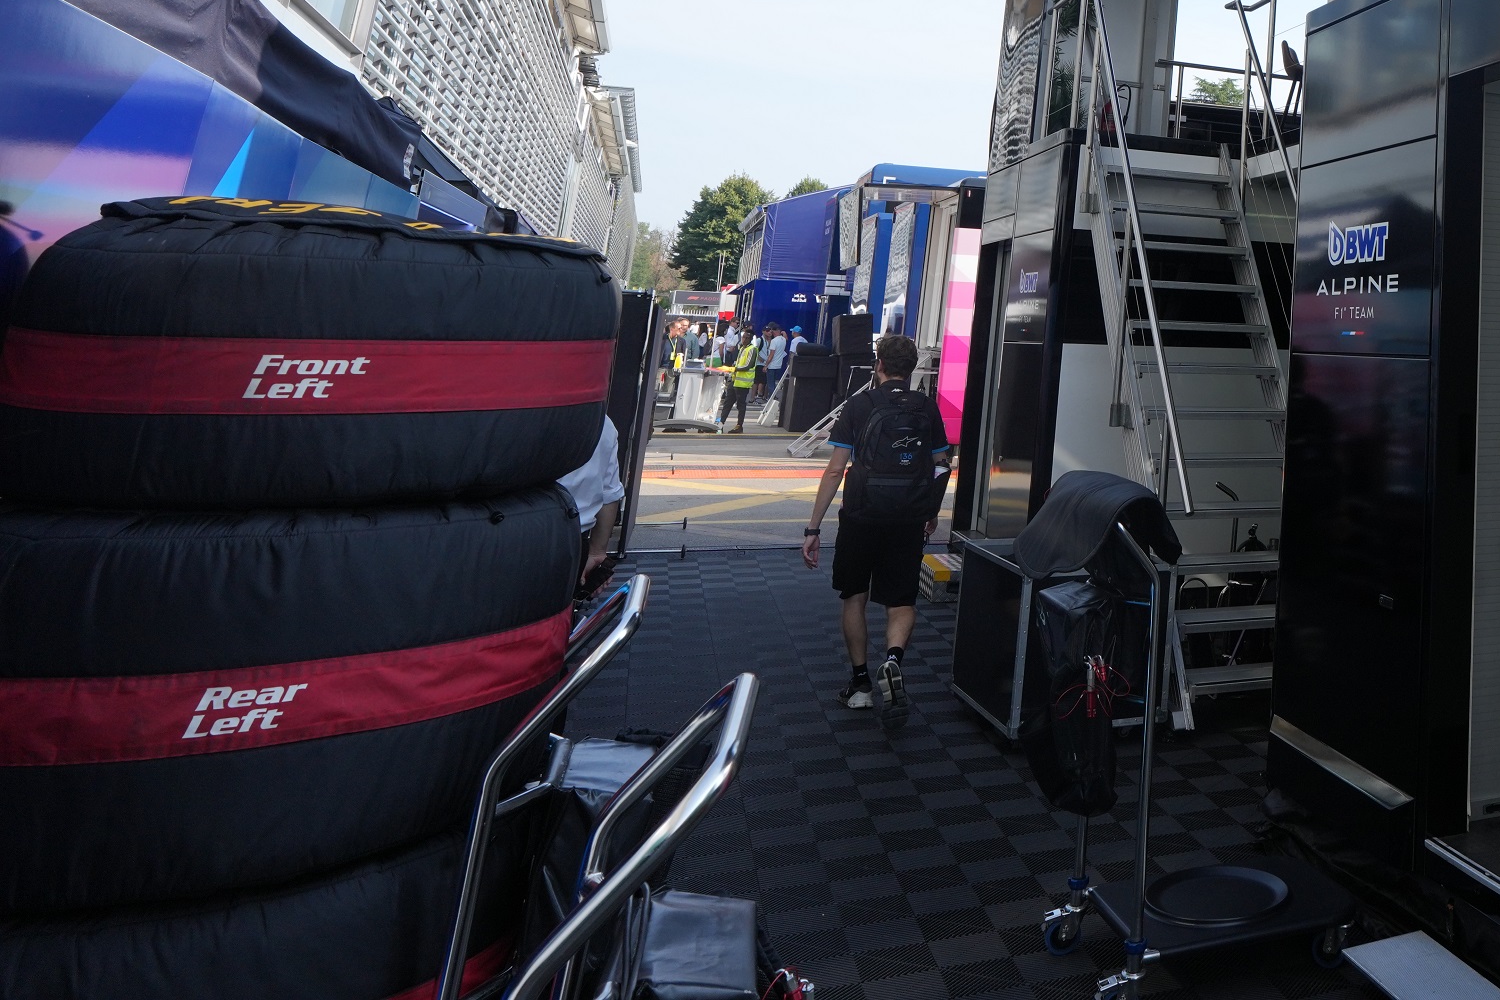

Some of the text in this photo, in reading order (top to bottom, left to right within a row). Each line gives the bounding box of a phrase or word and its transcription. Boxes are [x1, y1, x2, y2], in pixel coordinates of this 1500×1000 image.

[1344, 222, 1389, 264] BWT
[1316, 274, 1398, 296] ALPINE
[1349, 306, 1374, 319] TEAM
[253, 354, 371, 375] Front
[242, 378, 333, 399] Left
[195, 683, 308, 712] Rear
[182, 708, 283, 739] Left
